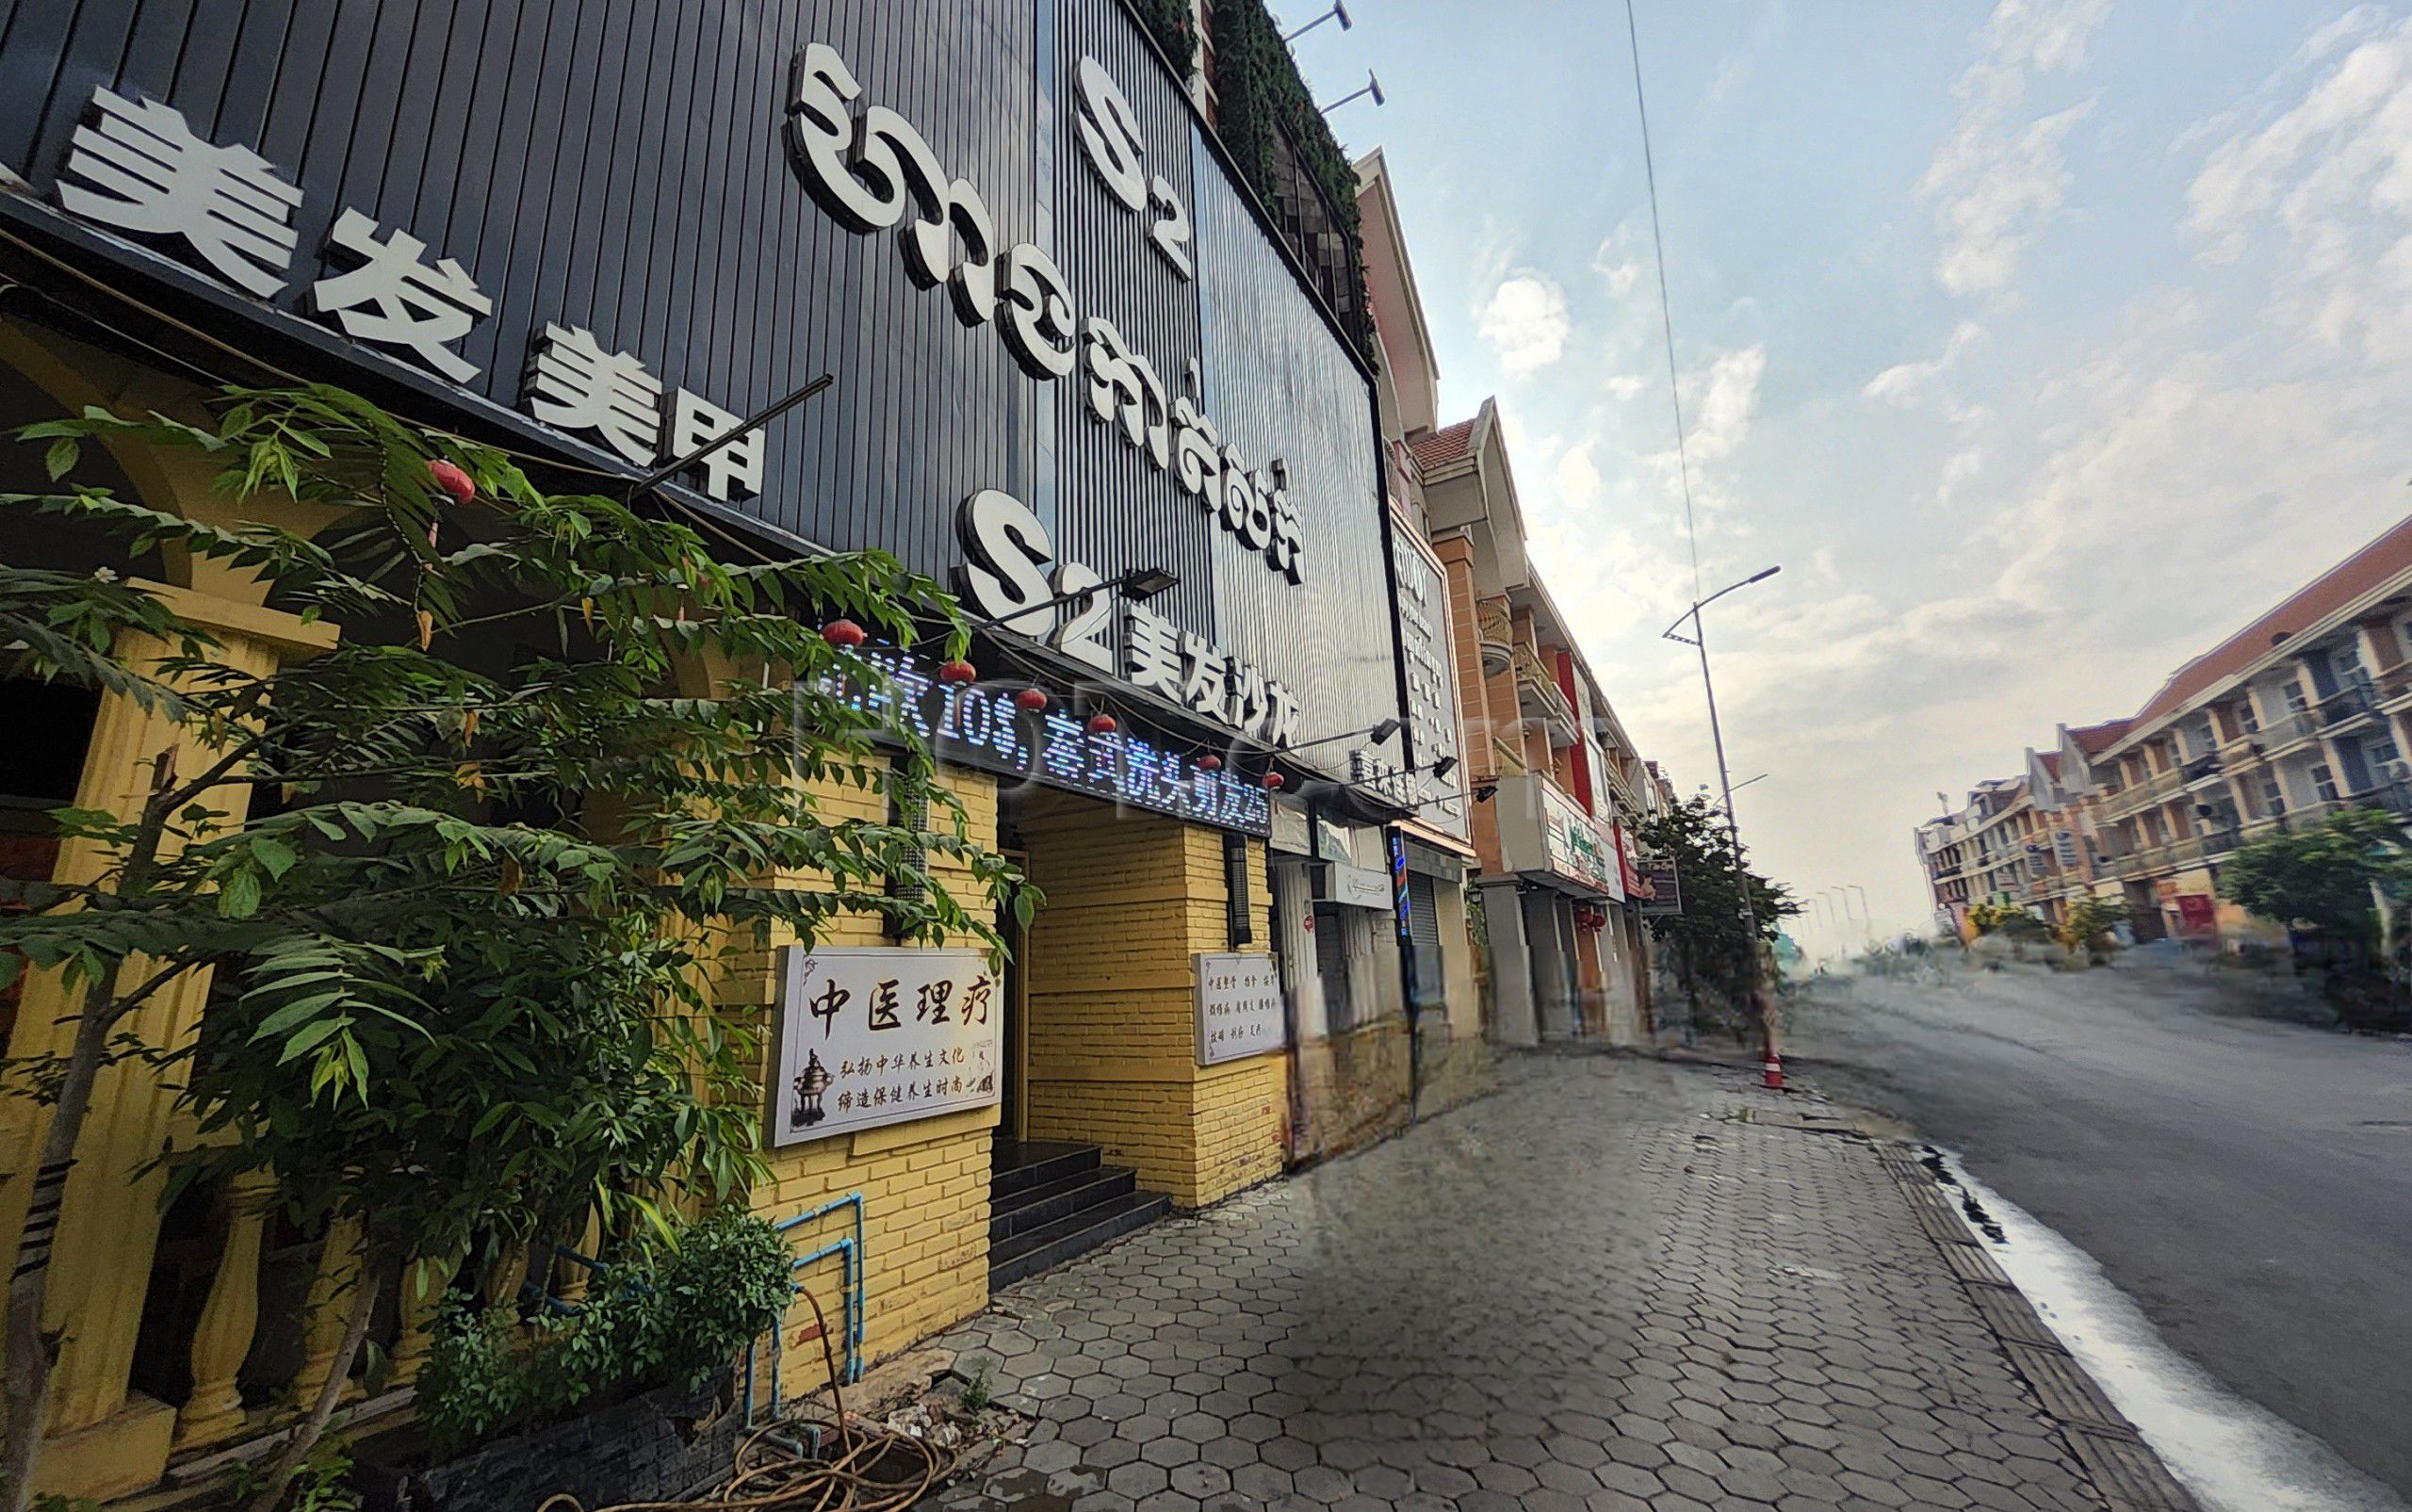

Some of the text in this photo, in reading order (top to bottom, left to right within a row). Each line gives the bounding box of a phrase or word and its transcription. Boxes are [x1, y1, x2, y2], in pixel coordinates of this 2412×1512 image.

[1073, 55, 1193, 282] S2
[55, 84, 766, 502] 美发美甲
[1127, 603, 1301, 750] 美发沙龙
[807, 974, 995, 1041] 中医理疗
[837, 1077, 964, 1114] 缔造保健养生时尚
[839, 1047, 966, 1080] 弘扬中华养生文化
